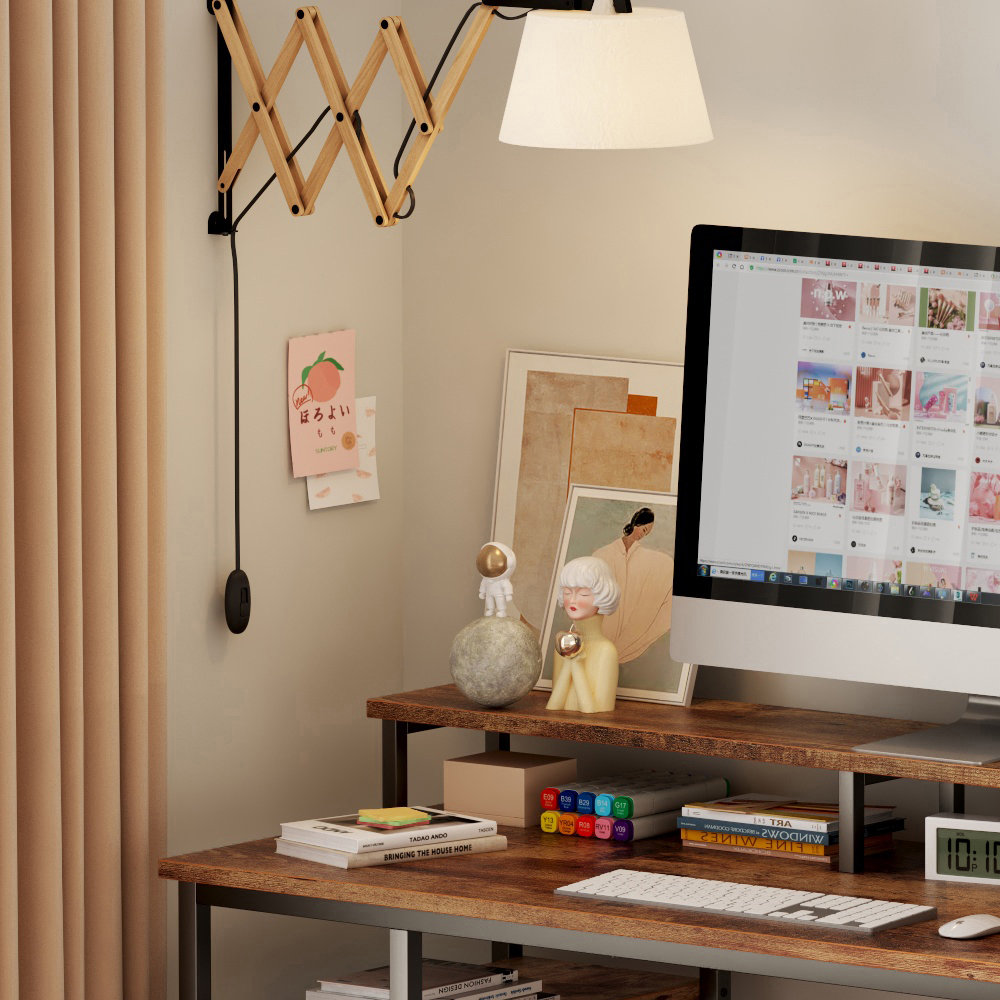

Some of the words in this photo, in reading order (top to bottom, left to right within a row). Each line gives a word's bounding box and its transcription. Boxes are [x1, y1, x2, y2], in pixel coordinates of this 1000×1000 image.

[301, 405, 350, 424] ほろよい
[317, 426, 336, 438] もも
[543, 793, 554, 801] E09
[595, 823, 610, 831] RV11
[409, 834, 430, 843] TADAO
[431, 832, 448, 841] ANDO
[384, 851, 416, 862] BRINGING
[417, 849, 430, 857] THE
[431, 846, 453, 856] HOUSE
[454, 844, 472, 853] HOME
[463, 976, 492, 990] FASHION
[438, 984, 462, 994] DESIGN
